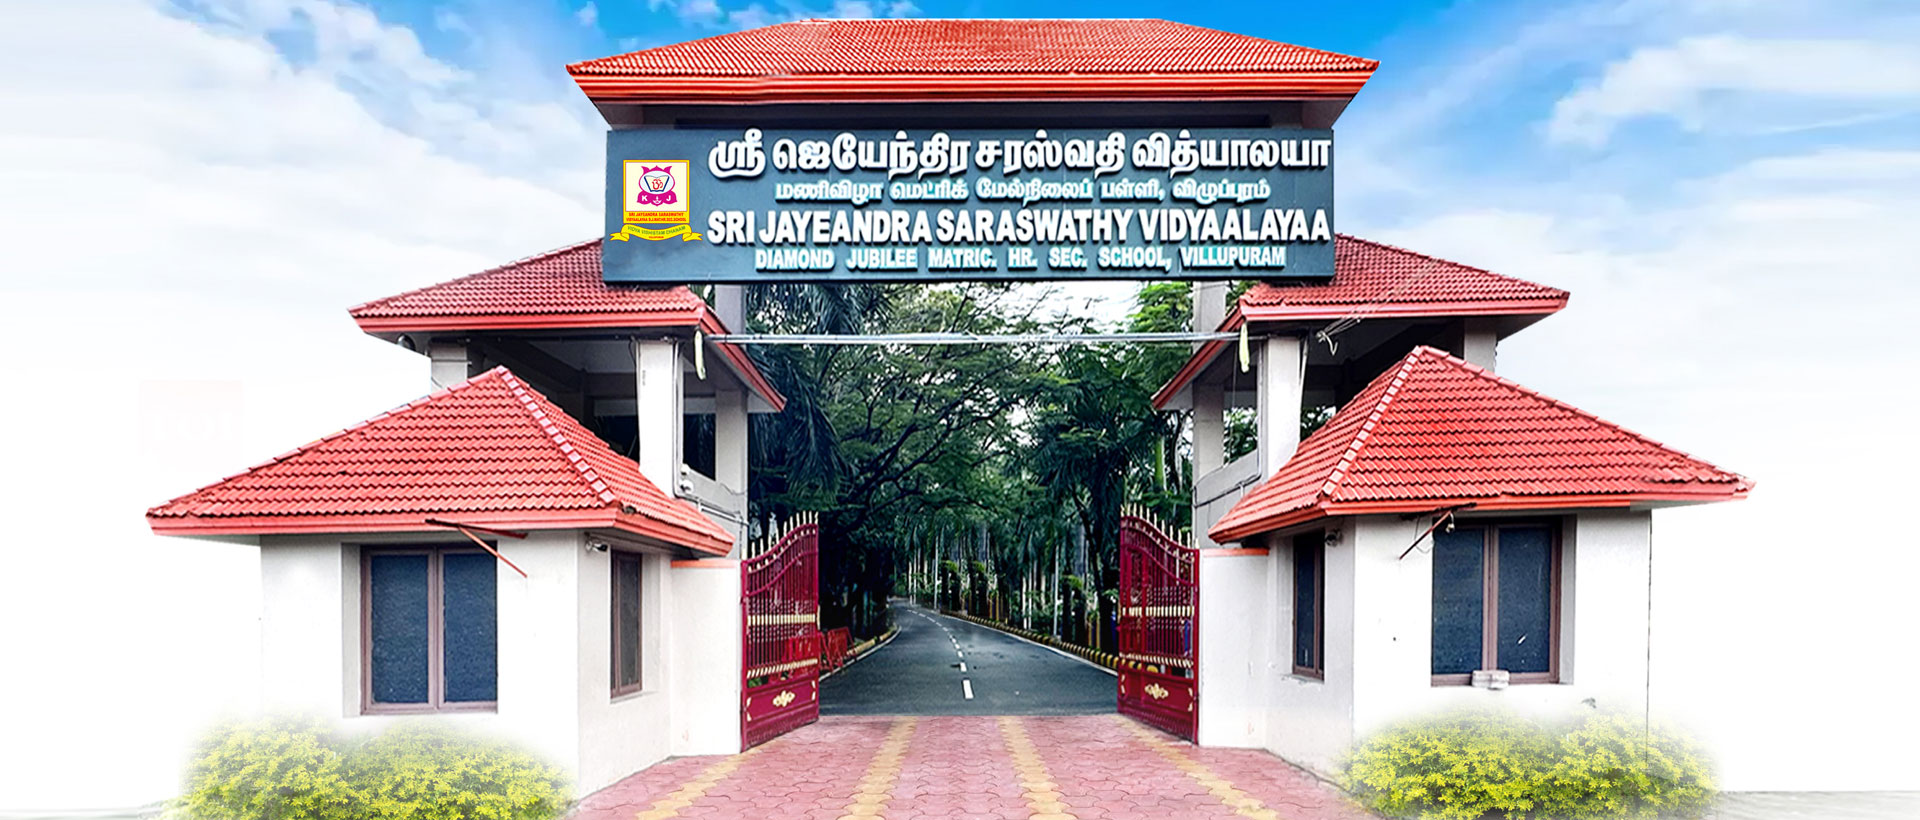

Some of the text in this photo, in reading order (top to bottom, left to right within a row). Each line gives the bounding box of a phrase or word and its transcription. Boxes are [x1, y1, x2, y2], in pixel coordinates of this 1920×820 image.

[772, 131, 971, 180] ஜெயேந்திர
[975, 129, 1126, 178] சரஸ்வதி
[1132, 129, 1331, 178] வித்யாலயா
[775, 177, 1271, 207] மணிவிழா மெட்ரிக் மேல்நிலைப் பள்ளி, விழுப்புரம்
[707, 209, 1331, 244] SRI JAYEANDRA SARASWATHY VIDYAALAYAA
[756, 246, 1286, 271] DIAMOND JUBILEE MATRIC. HR. SEC. SCHOOL, VILLUPURAM
